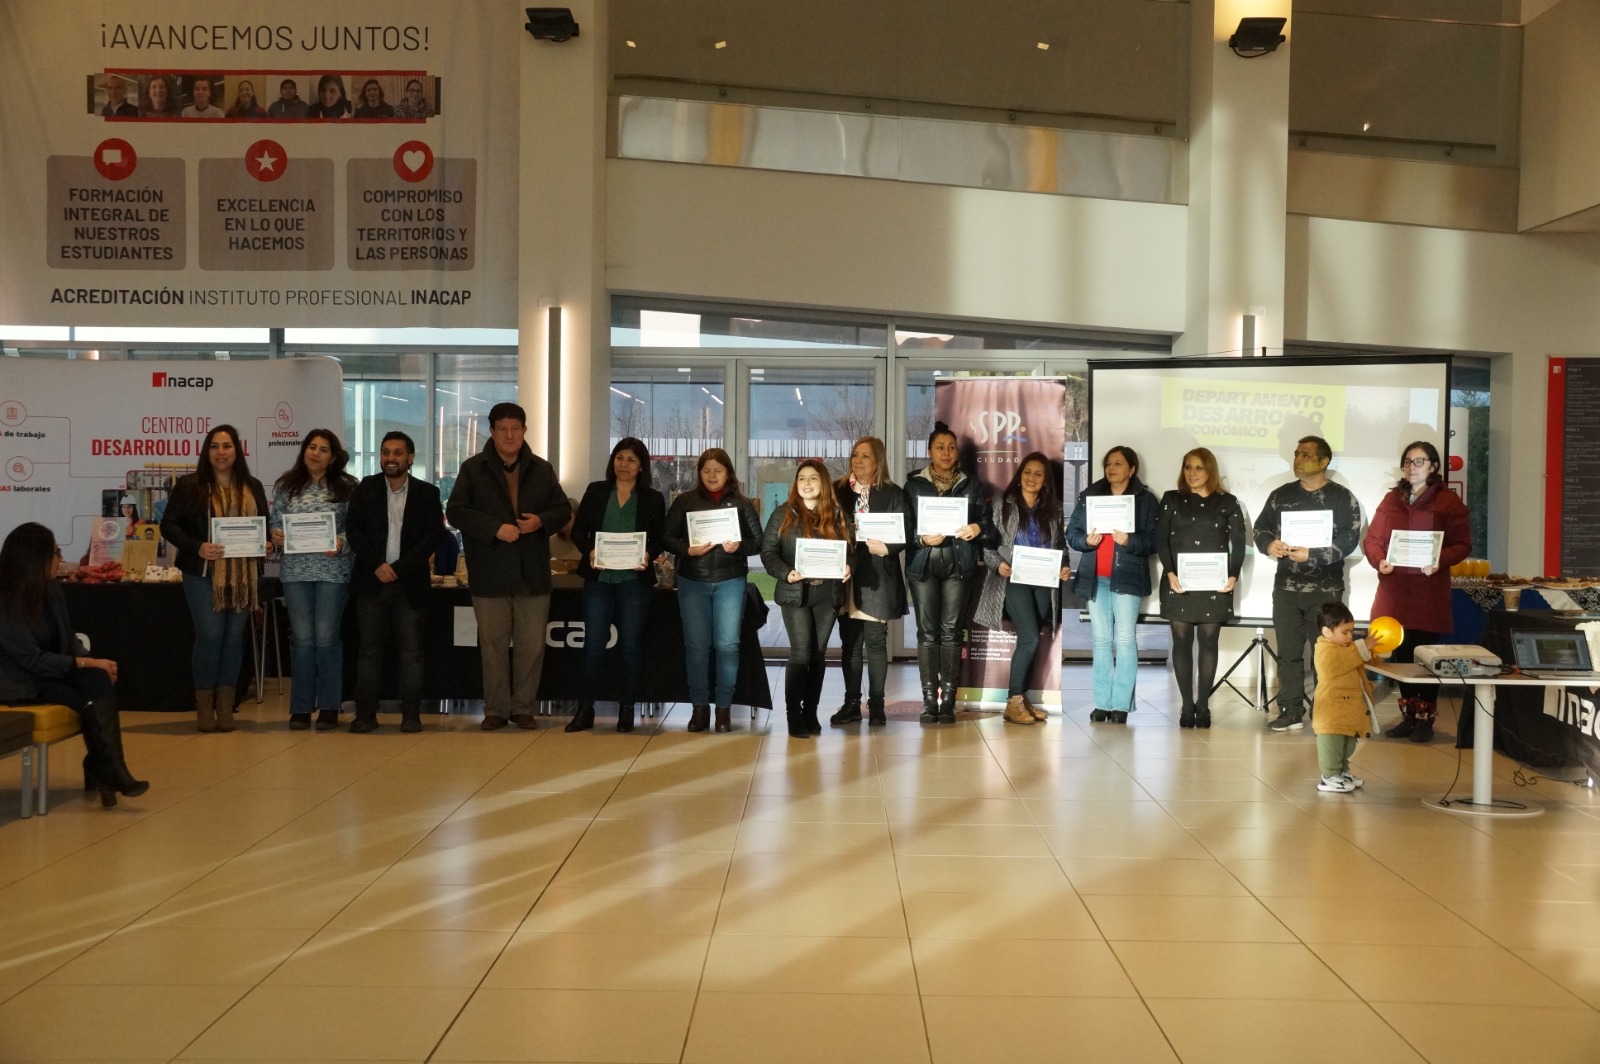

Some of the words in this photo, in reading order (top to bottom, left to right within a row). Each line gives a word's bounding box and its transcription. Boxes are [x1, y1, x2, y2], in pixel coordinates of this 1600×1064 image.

[100, 23, 294, 52] ¡AVANCEMOS
[301, 25, 430, 52] JUNTOS!
[69, 186, 164, 204] FORMACIÓN
[362, 189, 464, 204] COMPROMISO
[216, 198, 316, 214] EXCELENCIA
[63, 207, 146, 222] INTEGRAL
[149, 208, 170, 223] DE
[381, 207, 413, 223] CON
[416, 207, 445, 223] LOS
[74, 226, 160, 241] NUESTROS
[224, 217, 246, 232] EN
[249, 217, 271, 232] LO
[274, 217, 306, 234] QUE
[356, 227, 455, 243] TERRITORIOS
[458, 228, 468, 242] Y
[228, 236, 305, 251] HACEMOS
[60, 245, 174, 261] ESTUDIANTES
[355, 246, 386, 261] LAS
[389, 246, 469, 261] PERSONAS
[51, 286, 185, 306] ACREDITACIÓN
[188, 289, 282, 306] INSTITUTO
[285, 289, 408, 307] PROFESIONAL
[411, 289, 472, 306] INACAP
[1182, 387, 1327, 409] DEPARTAMENTO
[141, 416, 194, 435] CENTRO
[196, 416, 212, 434] DE
[1183, 422, 1268, 438] ECONÓMICO
[16, 431, 46, 439] trabajo
[91, 438, 192, 457] DESARROLLO
[13, 485, 51, 493] laborales
